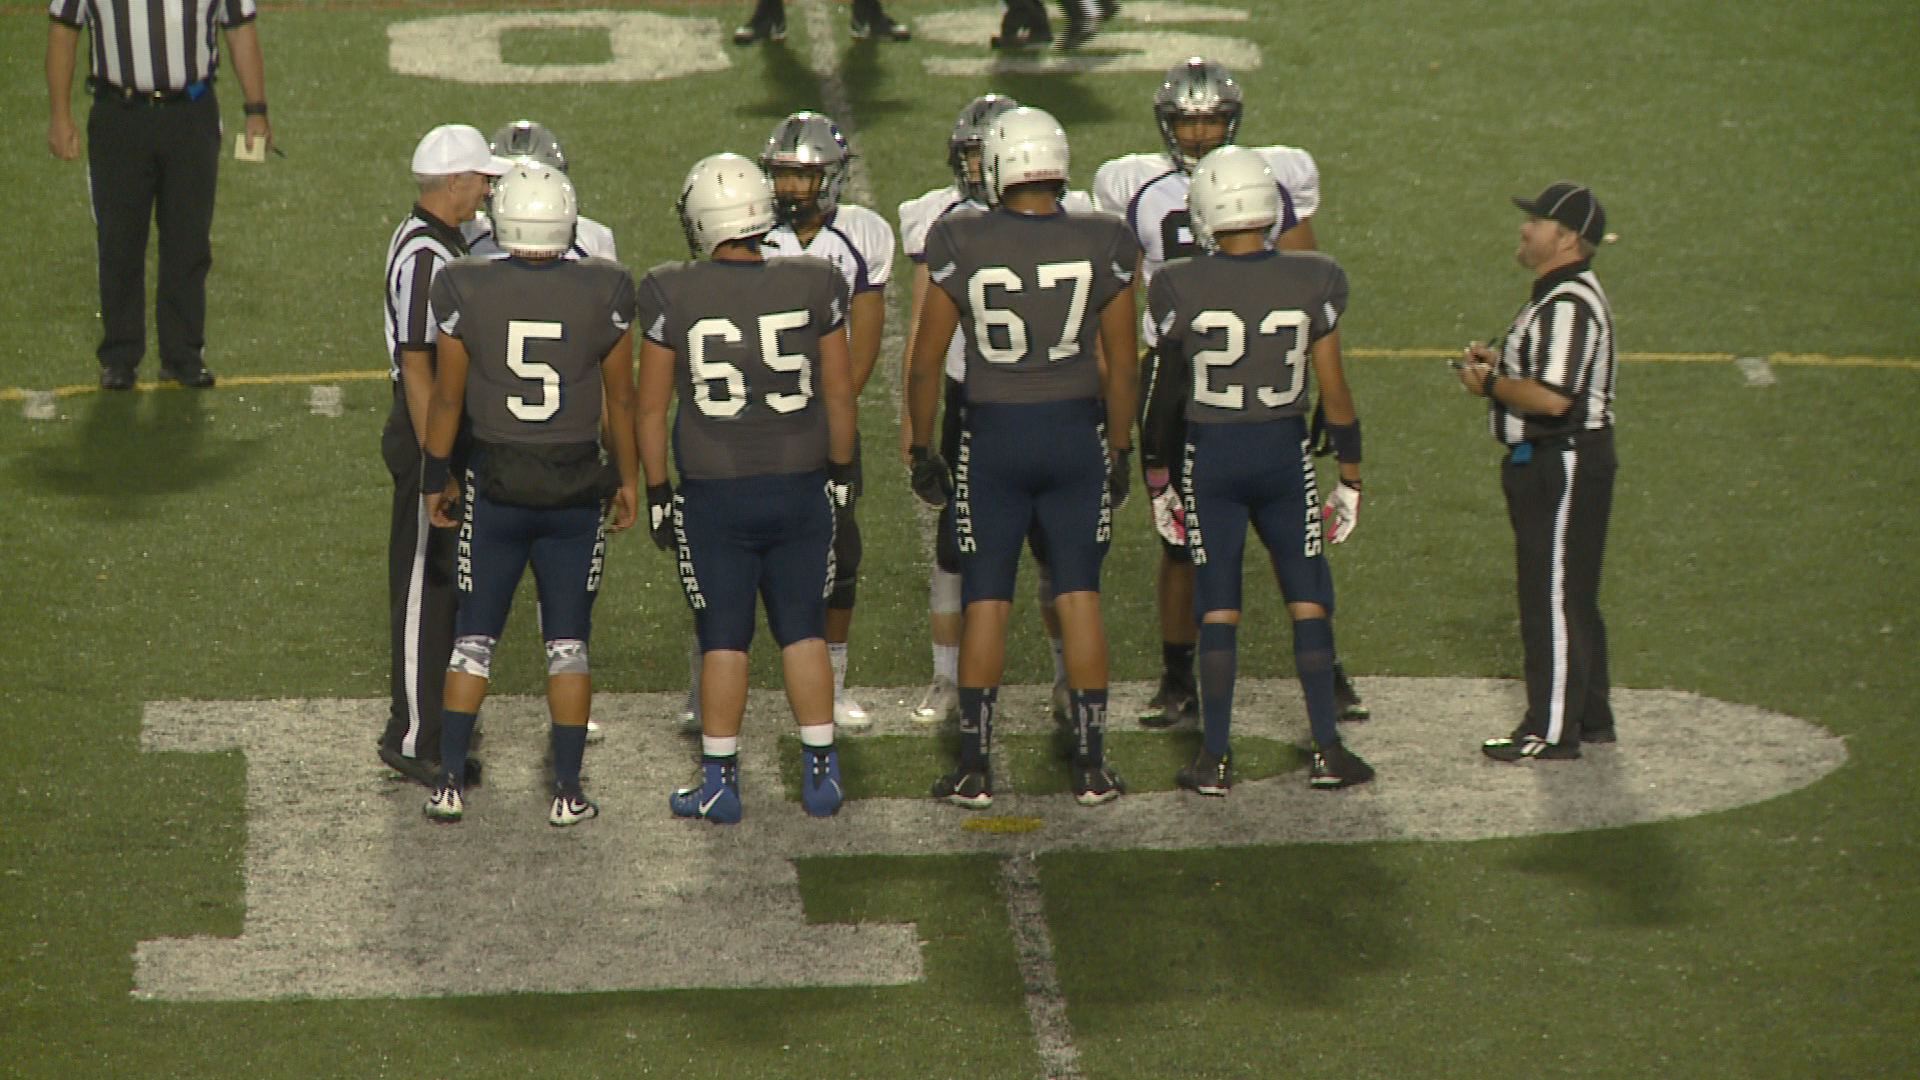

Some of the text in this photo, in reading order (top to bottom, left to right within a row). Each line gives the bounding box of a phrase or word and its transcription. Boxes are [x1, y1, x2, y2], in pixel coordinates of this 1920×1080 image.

[688, 310, 813, 417] 65
[967, 261, 1093, 364] 67
[1191, 309, 1310, 409] 23
[505, 320, 562, 421] 5
[457, 468, 475, 592] LANCERS
[672, 494, 706, 609] LANCERS
[1180, 443, 1207, 565] LANCERS
